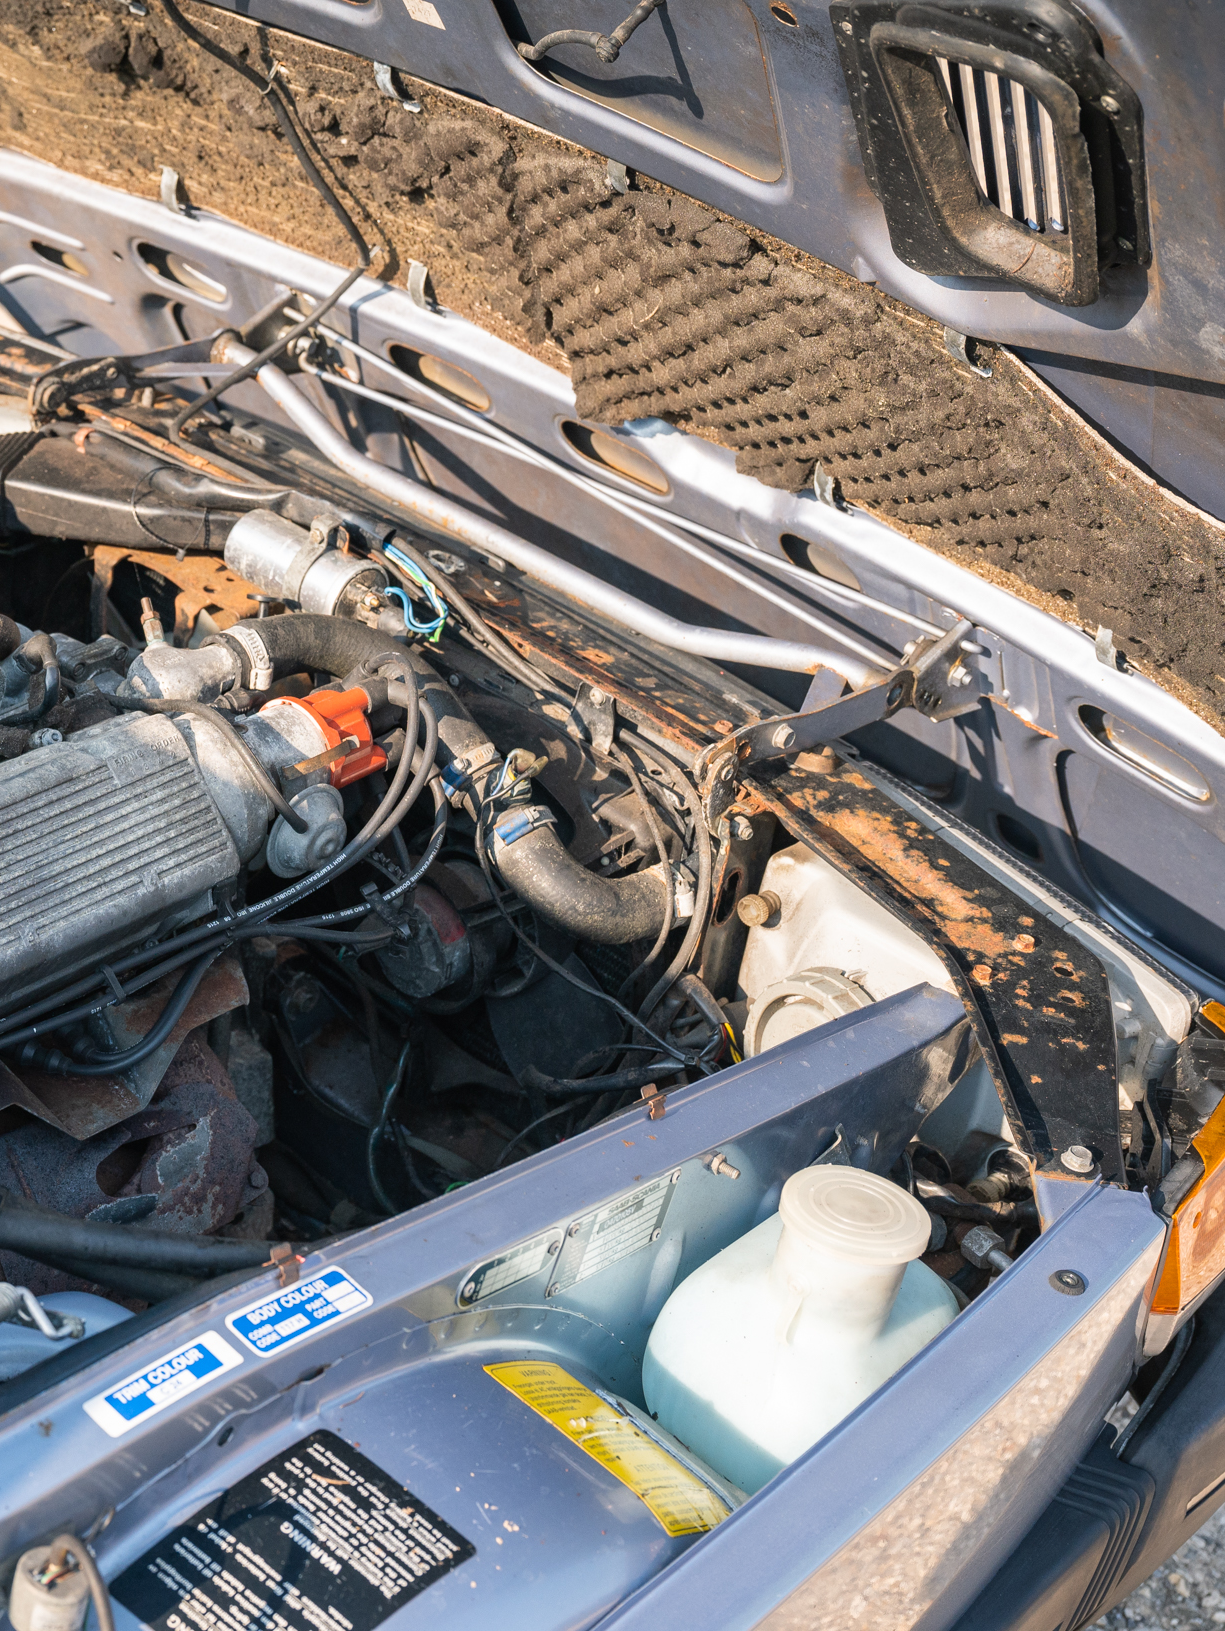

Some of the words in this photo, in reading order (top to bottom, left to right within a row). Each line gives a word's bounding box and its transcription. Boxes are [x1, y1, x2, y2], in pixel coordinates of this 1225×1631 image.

[150, 735, 180, 751] ORDER
[332, 853, 347, 865] HIGH
[297, 863, 335, 892] TEMPERATURE
[246, 1300, 282, 1325] BODY
[280, 1279, 329, 1308] COLOUR
[112, 1377, 151, 1404] TRIM
[147, 1347, 204, 1385] COLOUR
[288, 1456, 305, 1469] the
[304, 1445, 331, 1467] battery
[322, 1449, 351, 1473] welding
[301, 1465, 314, 1475] to
[328, 1463, 358, 1487] positive
[259, 1475, 276, 1489] any
[265, 1470, 289, 1489] being
[302, 1476, 318, 1489] the
[353, 1474, 366, 1484] or
[277, 1490, 289, 1500] or
[285, 1486, 298, 1496] is
[313, 1485, 326, 1495] to
[354, 1484, 370, 1497] the
[361, 1480, 391, 1504] charger
[366, 1495, 386, 1510] first
[284, 1496, 322, 1526] connected
[324, 1507, 337, 1517] is
[335, 1502, 366, 1526] positive
[354, 1507, 371, 1520] the
[386, 1501, 414, 1523] battery
[291, 1512, 329, 1543] destroyed
[313, 1509, 350, 1539] alternator
[359, 1522, 376, 1535] the
[366, 1517, 385, 1532] and
[317, 1522, 356, 1553] incorrectly
[353, 1531, 370, 1544] the
[391, 1528, 408, 1541] the
[429, 1527, 443, 1538] be
[276, 1520, 345, 1575] WARNING
[322, 1539, 338, 1551] be
[347, 1536, 361, 1547] or
[381, 1529, 410, 1552] battery
[403, 1538, 416, 1548] of
[169, 1541, 206, 1571] batteriets
[177, 1535, 213, 1564] batteriets
[332, 1547, 350, 1561] will
[350, 1549, 362, 1559] is
[356, 1544, 387, 1568] battery
[365, 1540, 388, 1559] while
[345, 1558, 382, 1587] alternator
[356, 1555, 386, 1578] battery
[381, 1565, 399, 1580] the
[380, 1574, 396, 1587] the
[394, 1577, 409, 1588] of
[376, 1584, 395, 1599] The
